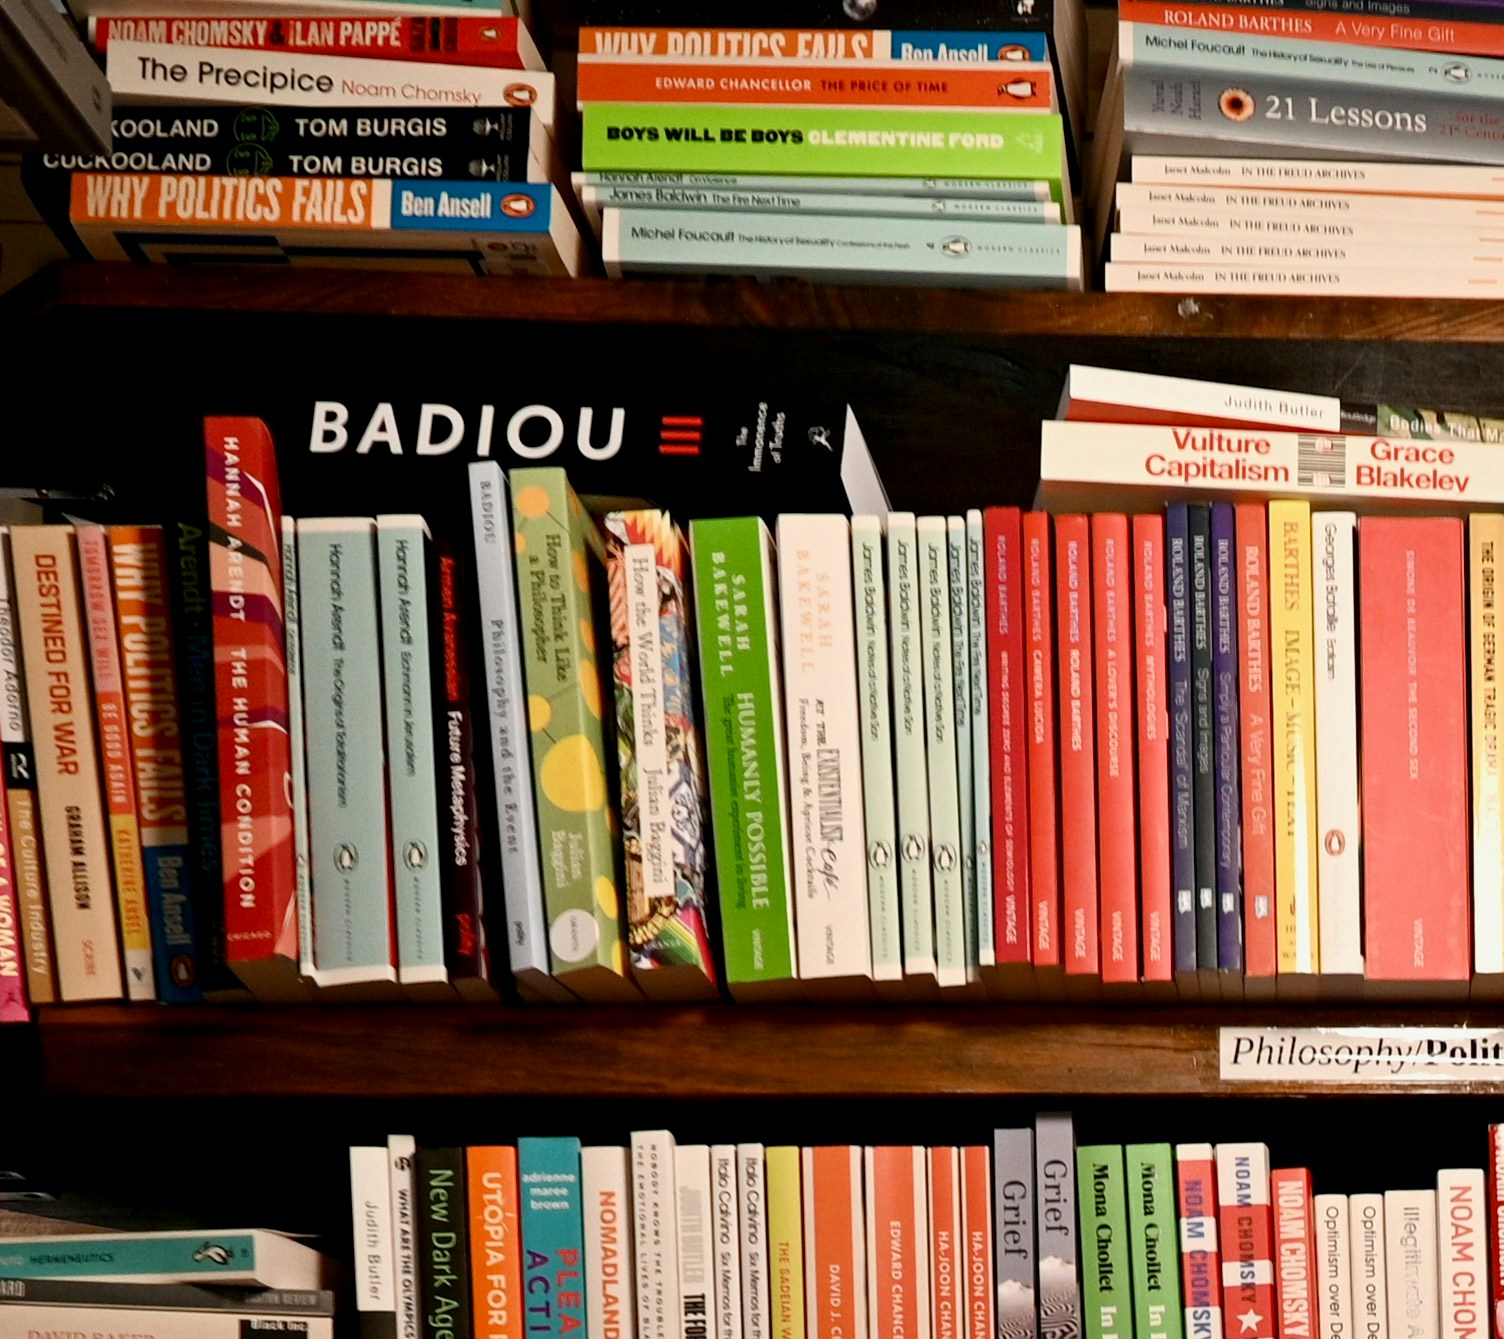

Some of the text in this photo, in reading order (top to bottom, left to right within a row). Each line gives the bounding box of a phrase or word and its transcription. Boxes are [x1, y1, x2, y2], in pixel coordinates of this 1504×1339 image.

[137, 55, 482, 106] The Precipice Noam Chomsky
[655, 76, 812, 95] EDWARD CHANCELLOR
[606, 126, 1004, 150] BOYS WILL BE BOYS CLEMENTINE FORD
[1265, 96, 1427, 133] 21 Lessons
[85, 174, 492, 226] WHY POLITICS FAILS Ben Ansell
[309, 400, 625, 461] BADIOU
[1171, 428, 1271, 454] Vulture
[1369, 439, 1455, 464] Grace
[1145, 454, 1290, 484] Capitalism
[223, 435, 244, 623] HANNAH ARENDT
[34, 552, 78, 776] DESTINED FOR WAR
[428, 1168, 452, 1223] New
[481, 1172, 505, 1267] UTOPIA
[1449, 1185, 1472, 1264] NOAM
[429, 1232, 456, 1290] Dark
[486, 1273, 508, 1327] FOR
